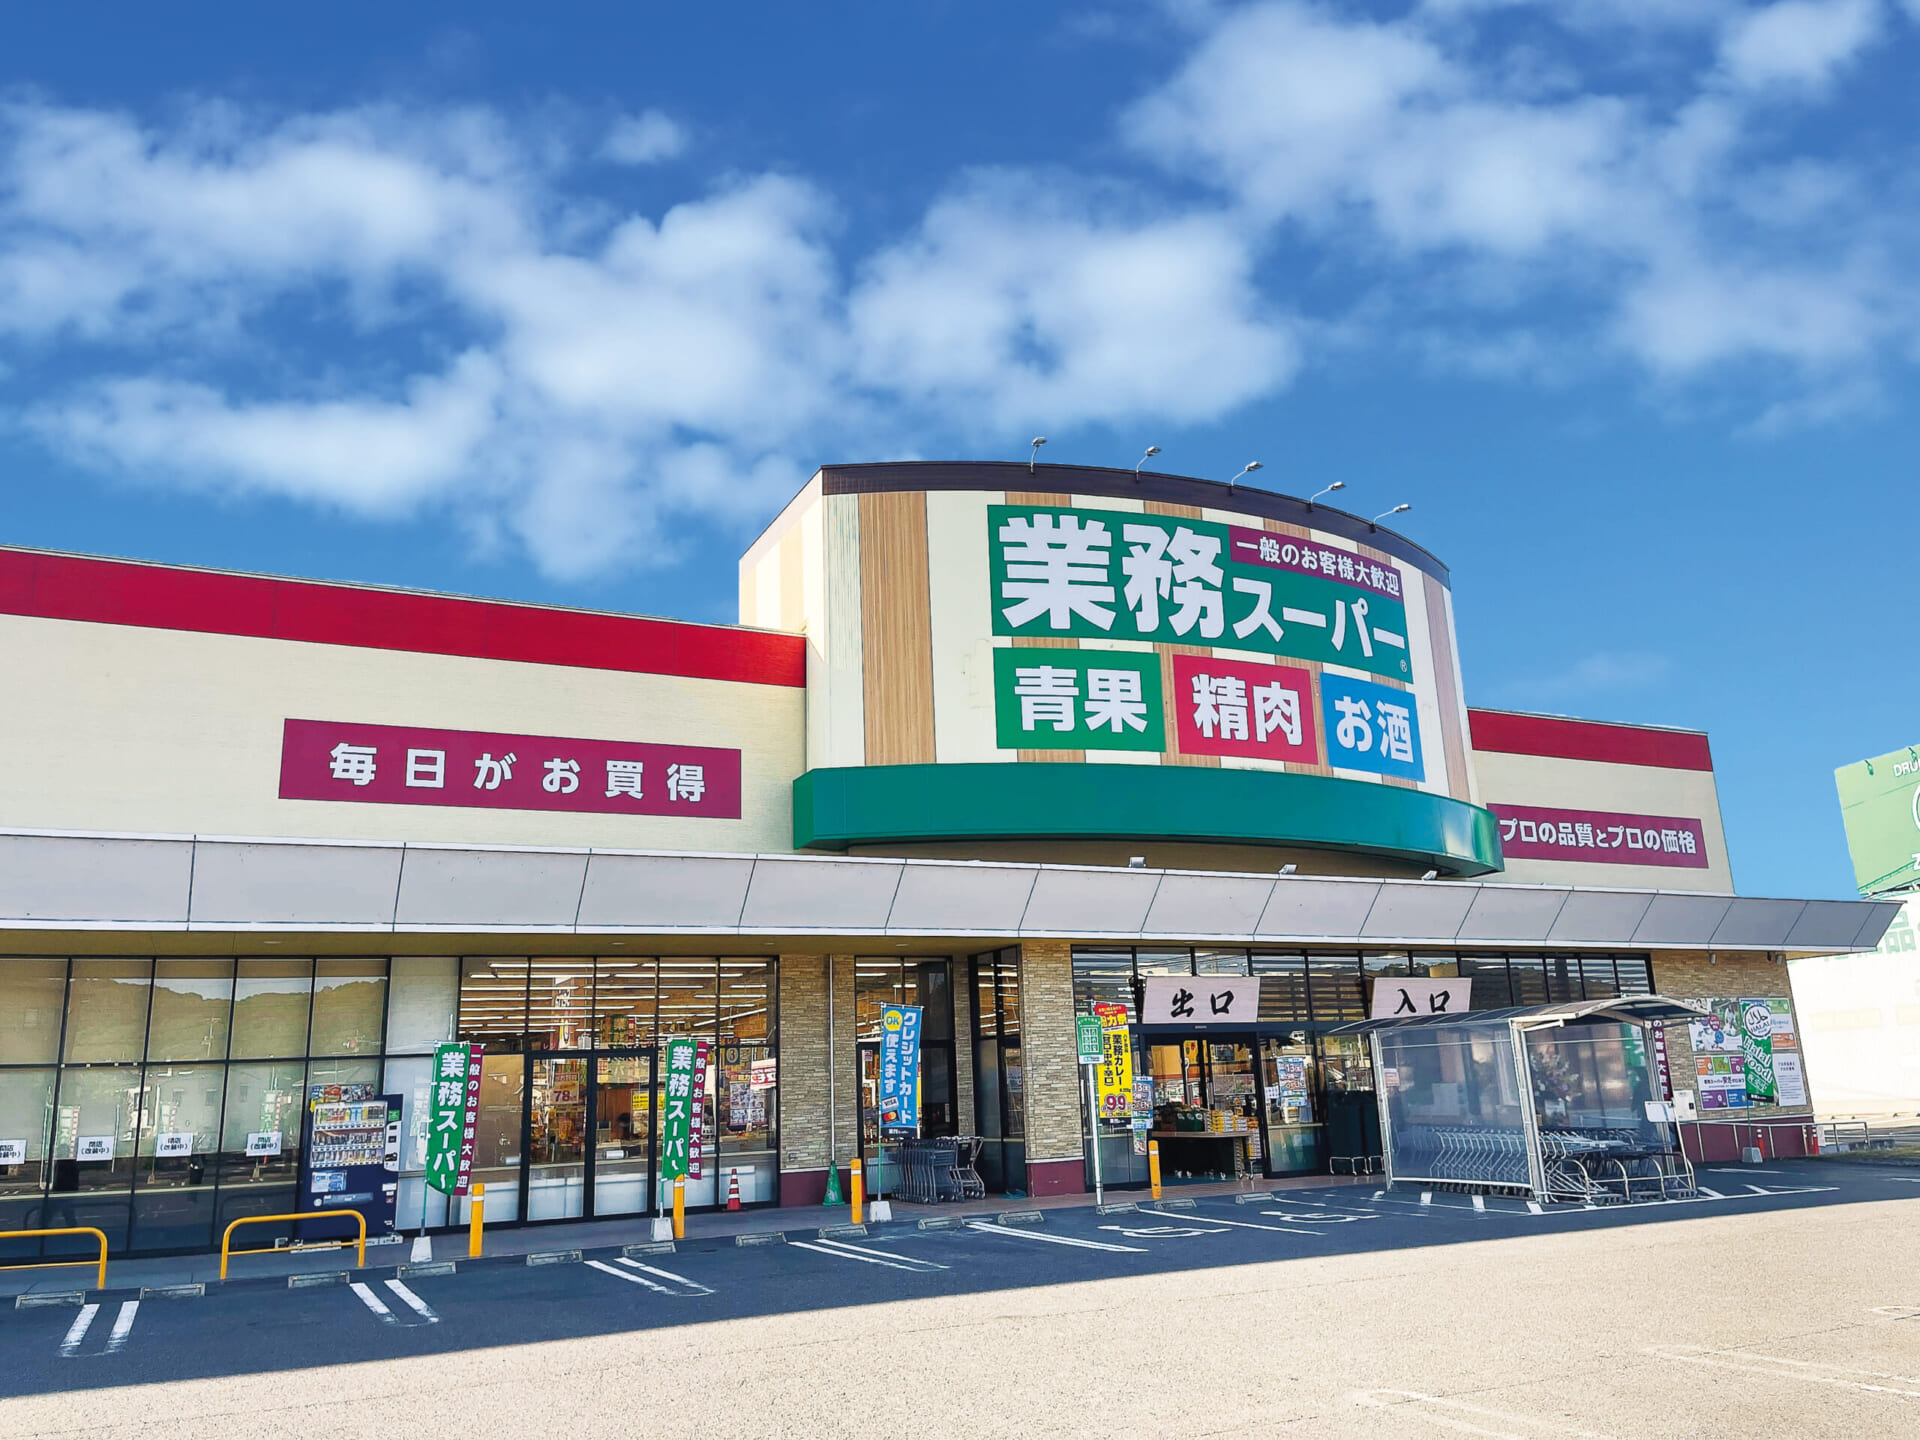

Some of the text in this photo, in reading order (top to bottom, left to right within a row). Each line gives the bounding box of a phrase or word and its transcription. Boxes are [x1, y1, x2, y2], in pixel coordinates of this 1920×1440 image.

[999, 513, 1405, 657] 業務スーパー
[1236, 536, 1400, 597] 一般のお客様大歓迎
[1014, 665, 1148, 734] 青果
[1190, 672, 1303, 747] 精肉
[1334, 694, 1415, 764] お酒
[328, 742, 706, 803] 毎日がお買得
[1500, 818, 1697, 855] プロの品質とプロの価格
[886, 1016, 899, 1026] OK
[1169, 987, 1235, 1019] 出口
[1393, 988, 1451, 1015] 入口
[884, 1033, 899, 1094] 使えます
[899, 1012, 917, 1125] クレジットカード
[1743, 1036, 1772, 1068] Halal
[1743, 1052, 1773, 1084] Food
[433, 1051, 466, 1189] 業務スーパー
[456, 1053, 482, 1188] 一般のお客様大歓迎
[554, 1090, 570, 1102] 78
[666, 1045, 693, 1171] 業務スーパー
[689, 1048, 707, 1173] 一般のお客様大歓迎
[1106, 1095, 1126, 1111] 99
